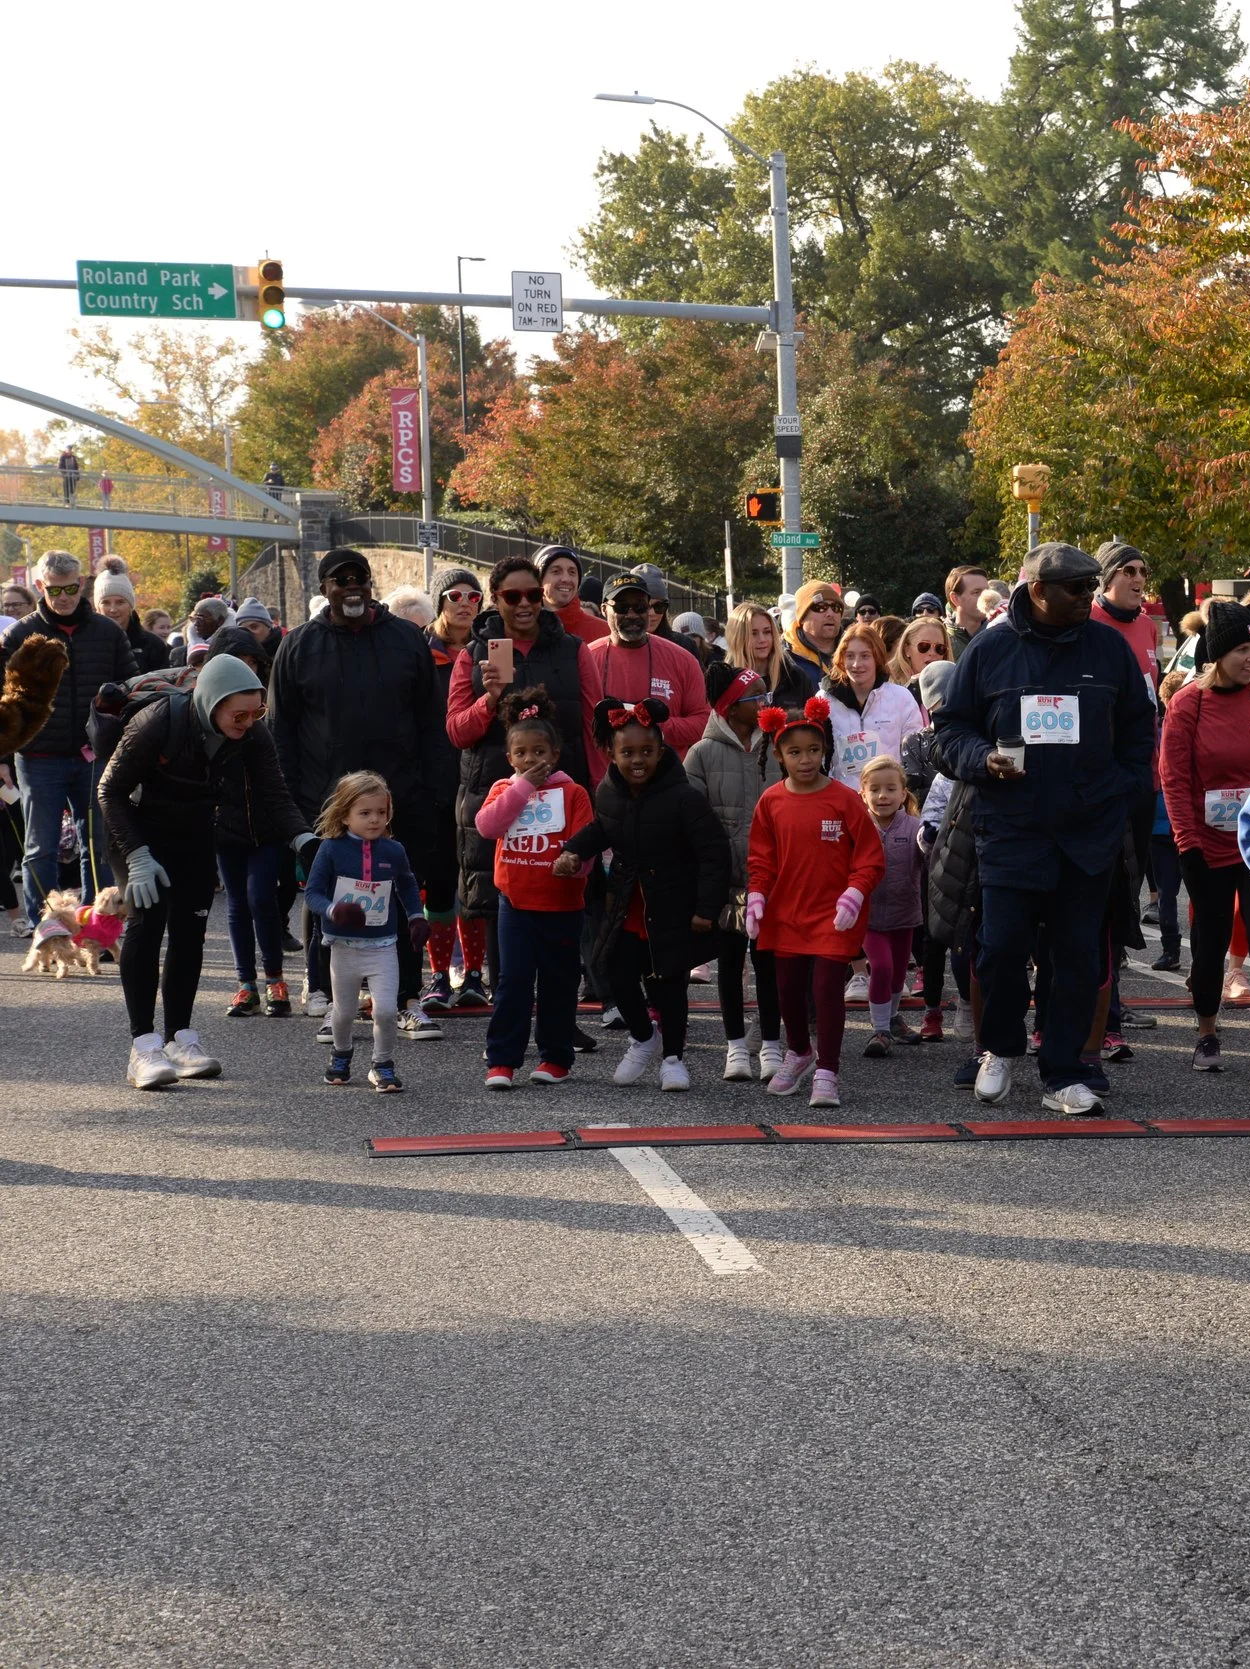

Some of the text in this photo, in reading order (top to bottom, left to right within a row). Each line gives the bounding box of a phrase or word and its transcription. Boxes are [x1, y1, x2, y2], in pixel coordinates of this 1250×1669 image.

[82, 268, 201, 287] Roland Park
[528, 276, 545, 285] NO
[84, 292, 203, 313] Country Sch
[524, 289, 551, 299] TURN
[518, 302, 557, 313] ON RED
[541, 317, 558, 328] 7PM
[397, 411, 414, 483] RPCS
[773, 534, 801, 544] Roland
[738, 669, 757, 685] RP
[651, 682, 670, 690] RUN
[1026, 711, 1074, 731] 606
[842, 741, 877, 763] 407
[519, 803, 553, 825] 56
[1211, 802, 1241, 821] 22
[517, 858, 528, 866] Park
[529, 859, 552, 868] Country
[340, 893, 386, 913] 404
